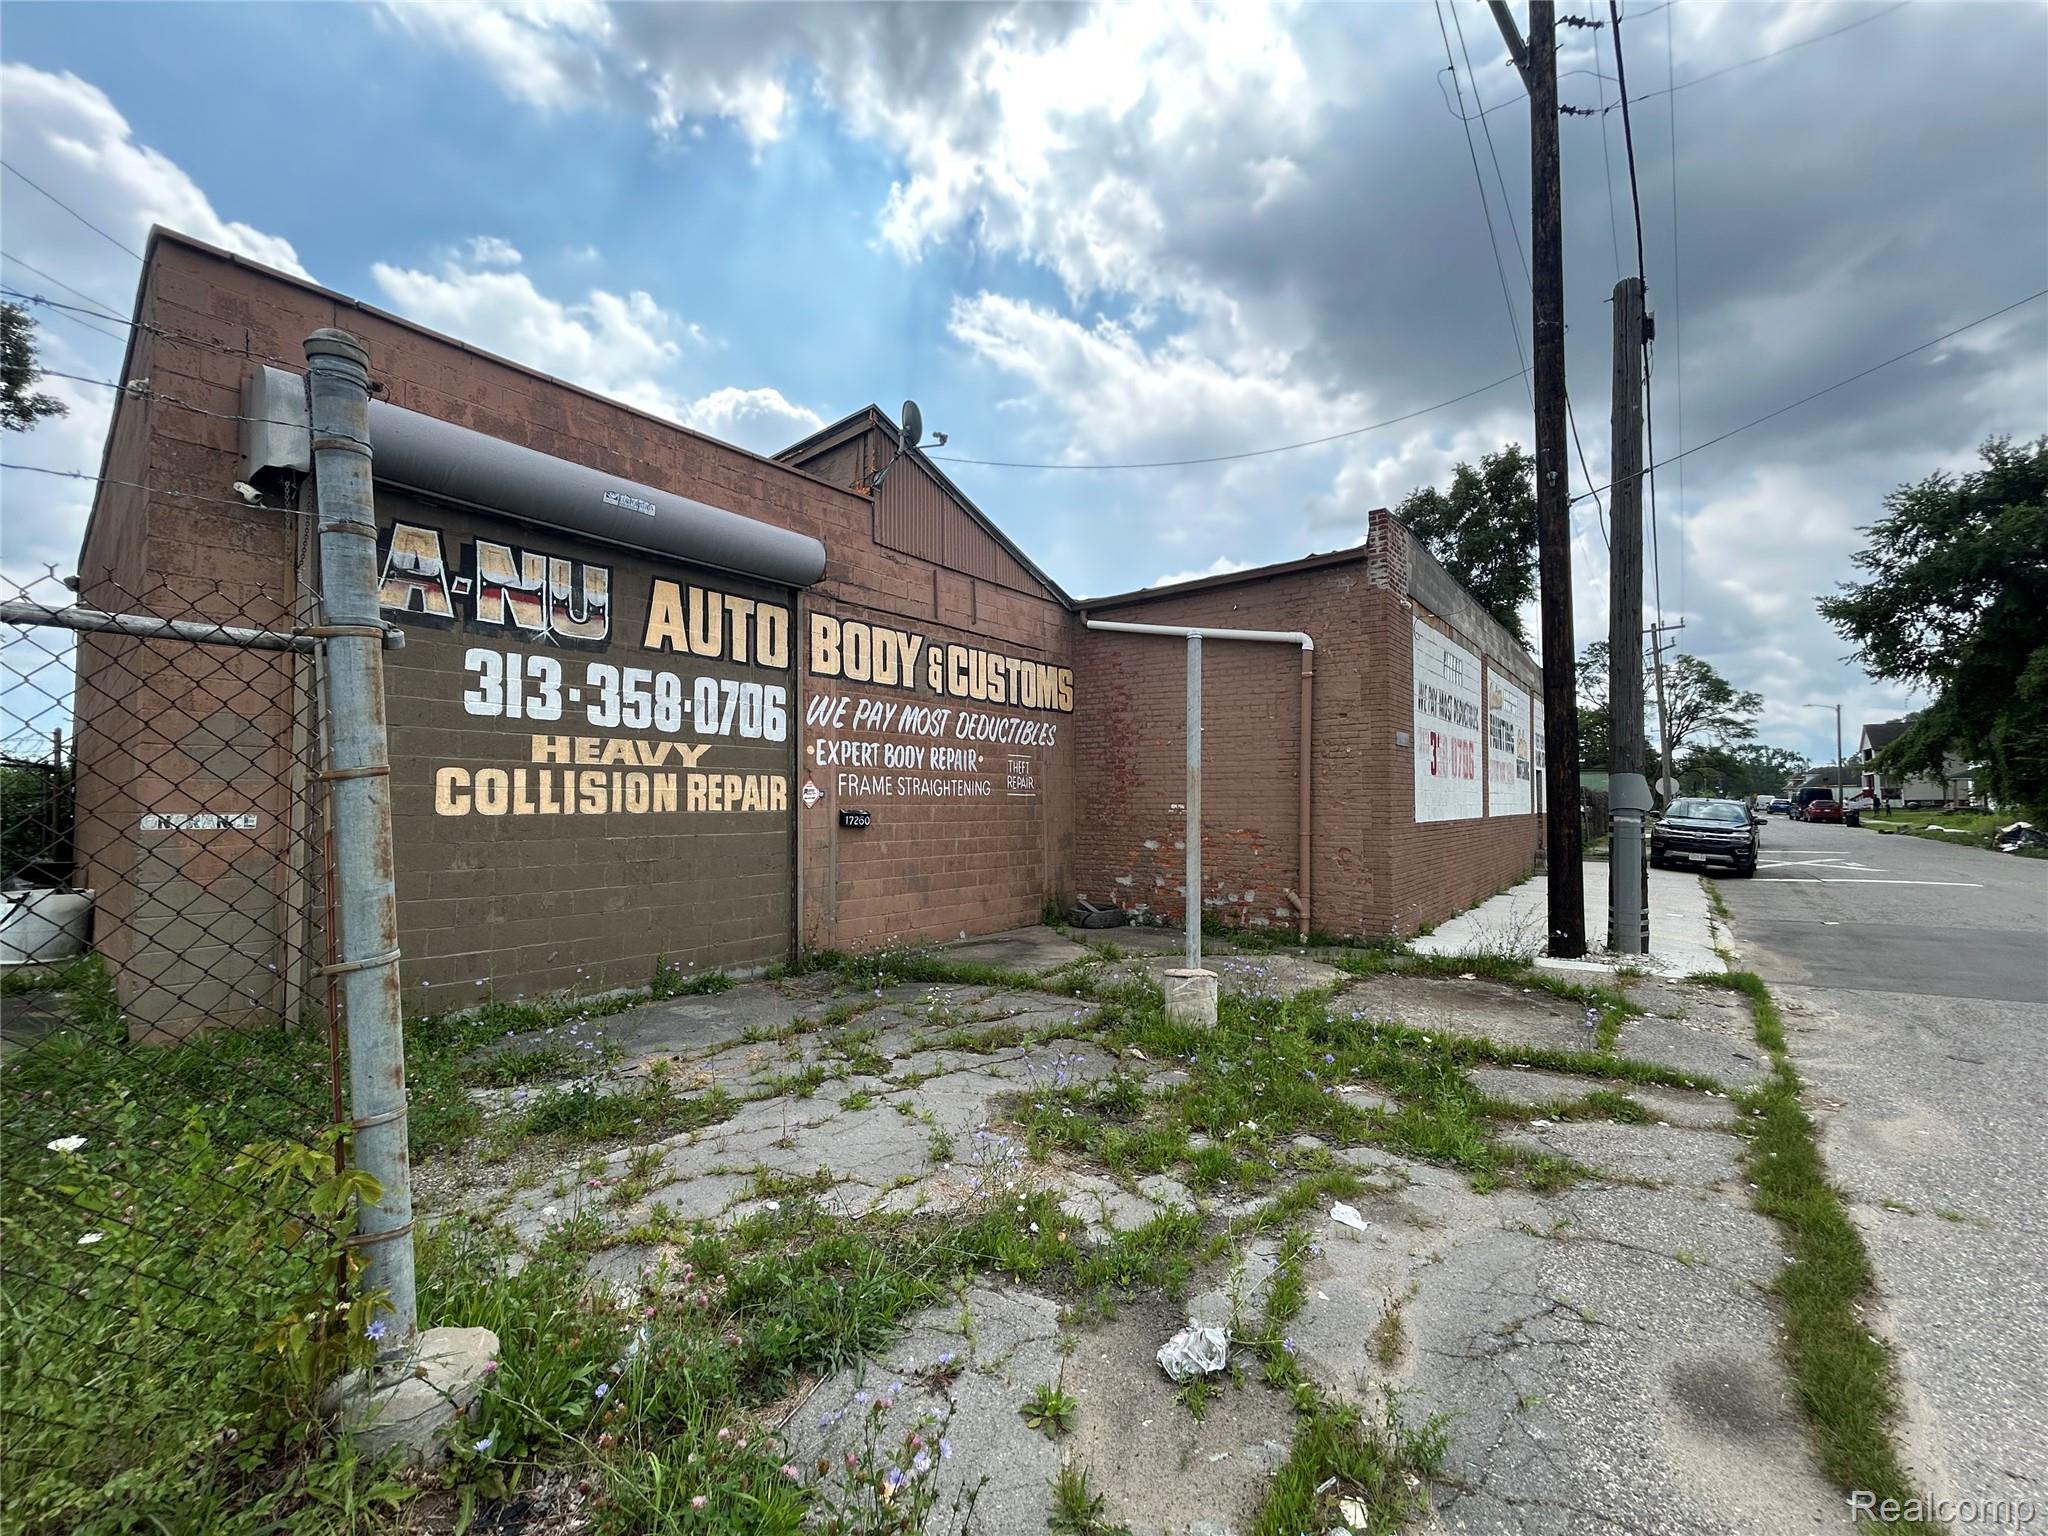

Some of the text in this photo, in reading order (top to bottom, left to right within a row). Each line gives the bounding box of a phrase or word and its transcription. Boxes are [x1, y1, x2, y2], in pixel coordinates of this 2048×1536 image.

[644, 580, 788, 669] AUTO
[811, 613, 922, 688] BODY
[928, 646, 943, 693] &
[947, 645, 1073, 712] CUSTOMS
[806, 694, 1056, 746] WE PAY MOST DEDUCTIBLES
[531, 734, 711, 768] HEAVY
[816, 739, 977, 772] EXPERT BODY REPAIR
[1007, 760, 1030, 774] THEFT
[435, 767, 676, 816] COLLISION
[687, 773, 787, 811] REPAIR
[838, 773, 892, 797] FRAME
[897, 776, 991, 797] STRAIGHTENING
[1007, 775, 1034, 790] REPAIR
[845, 815, 871, 826] 17260
